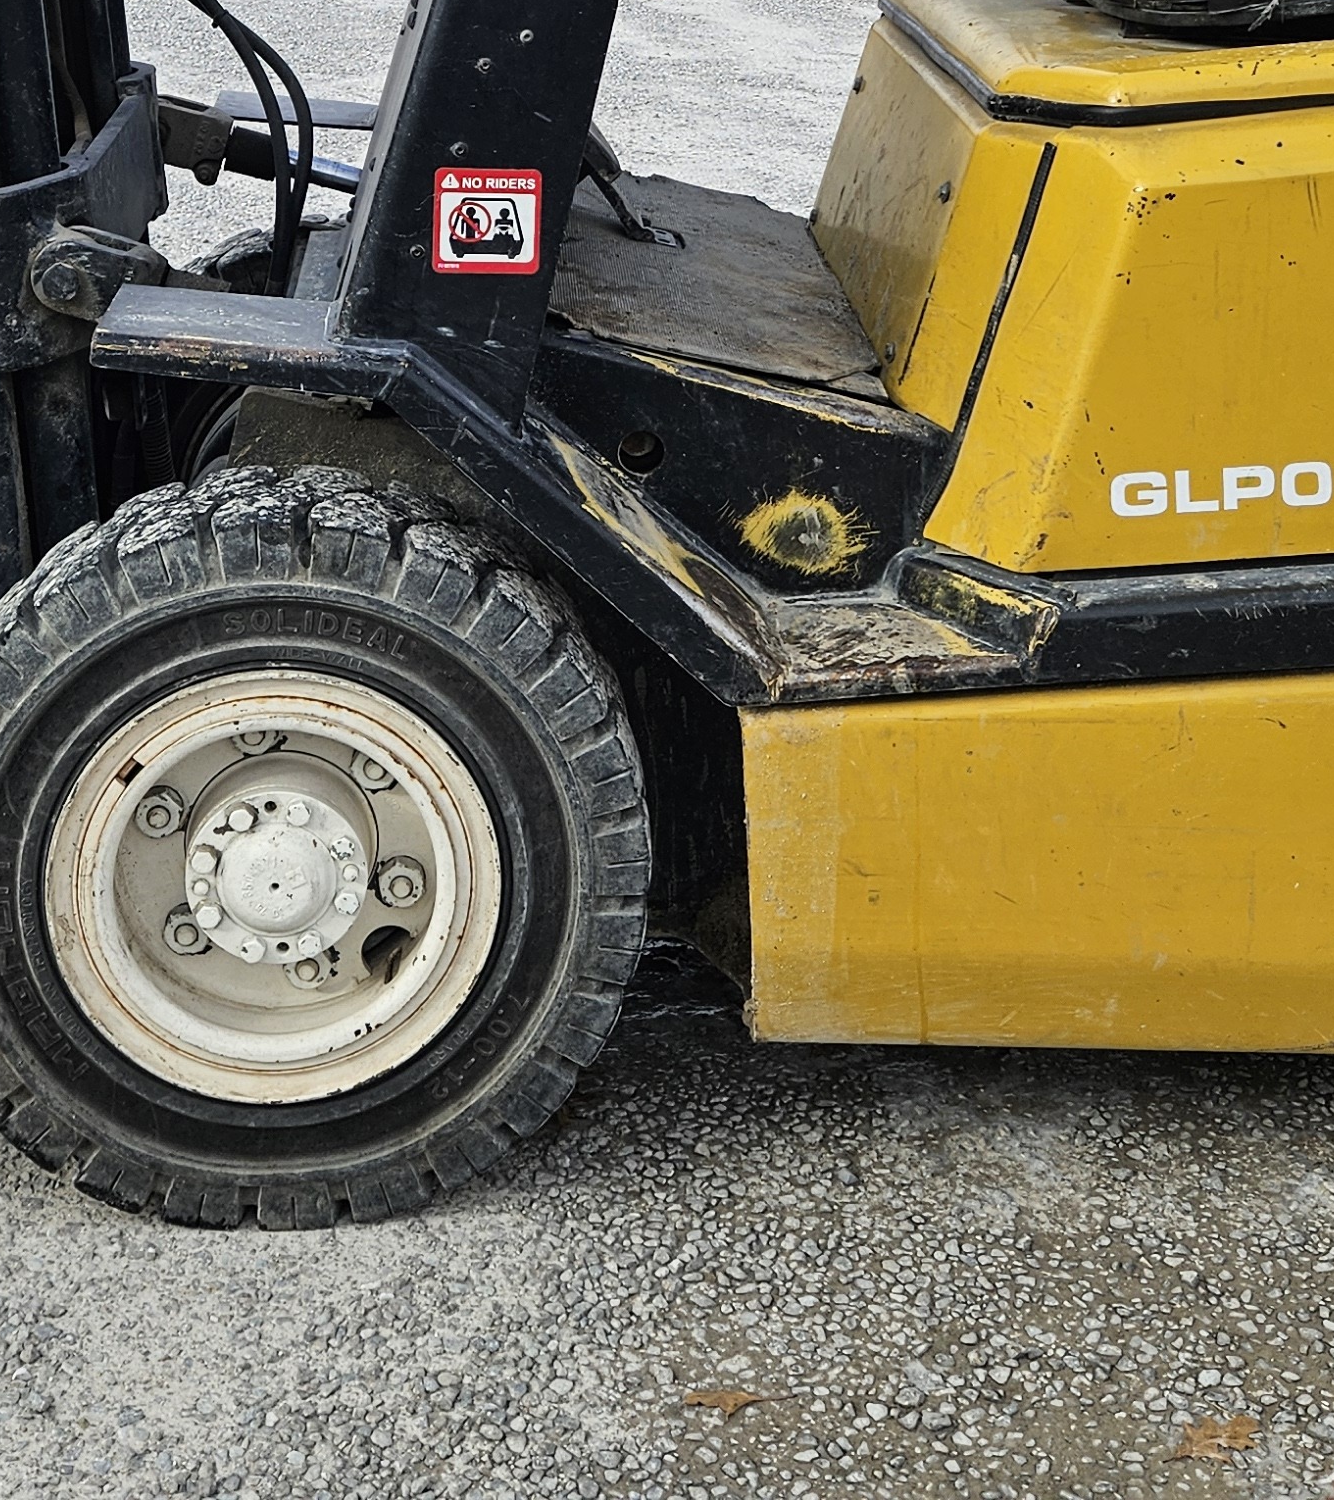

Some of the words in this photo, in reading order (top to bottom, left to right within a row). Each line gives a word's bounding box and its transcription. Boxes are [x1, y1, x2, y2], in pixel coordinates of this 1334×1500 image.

[461, 177, 483, 189] NO
[485, 177, 536, 190] RIDERS
[222, 608, 408, 661] SOLIDEAL
[429, 993, 531, 1100] 7.00-12
